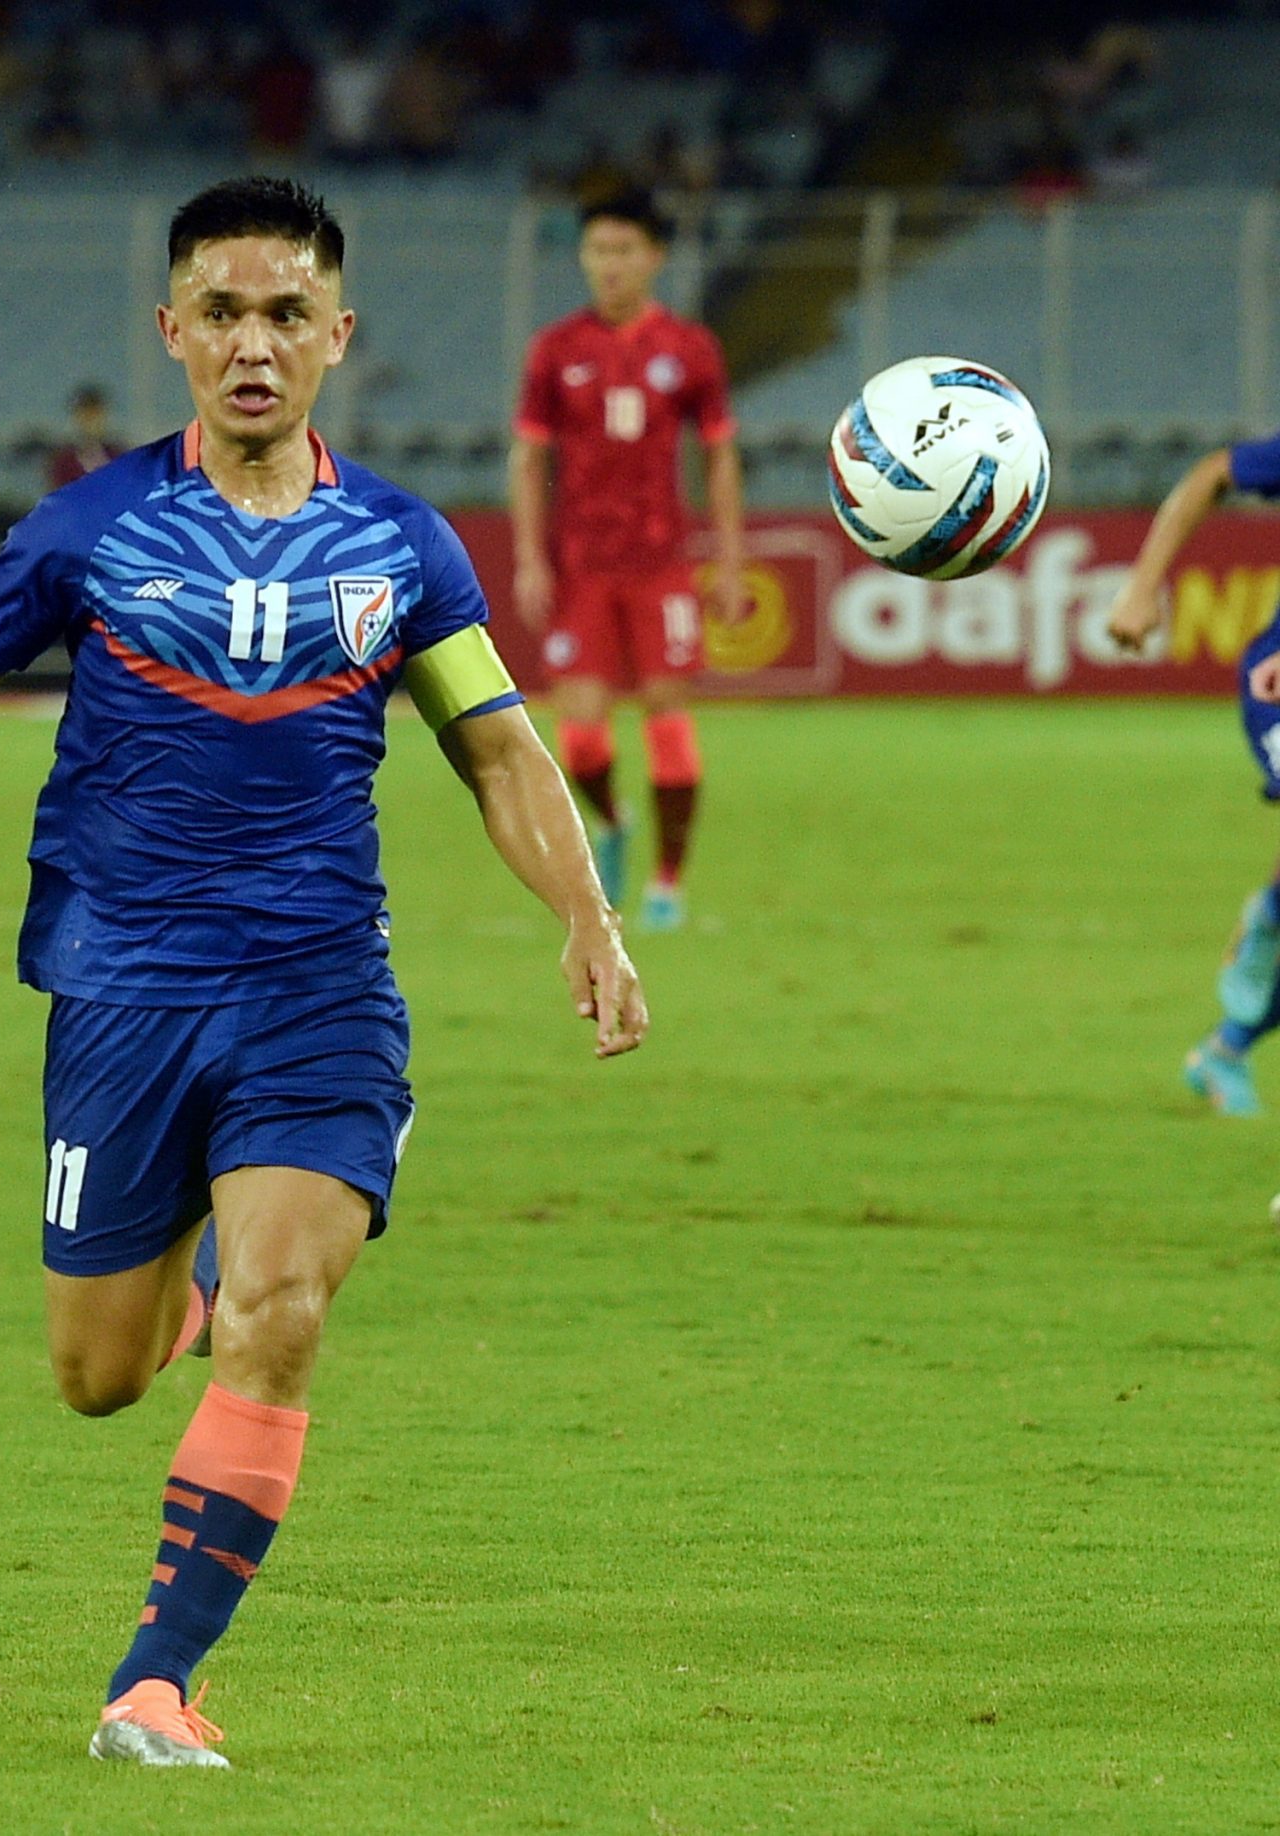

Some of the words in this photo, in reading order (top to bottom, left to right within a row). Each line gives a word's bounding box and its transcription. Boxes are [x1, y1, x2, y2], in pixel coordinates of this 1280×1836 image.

[912, 417, 971, 458] NIVIA
[224, 577, 290, 663] 11
[342, 585, 377, 597] INDIA
[830, 530, 1280, 690] dafaN
[44, 1137, 89, 1232] 11
